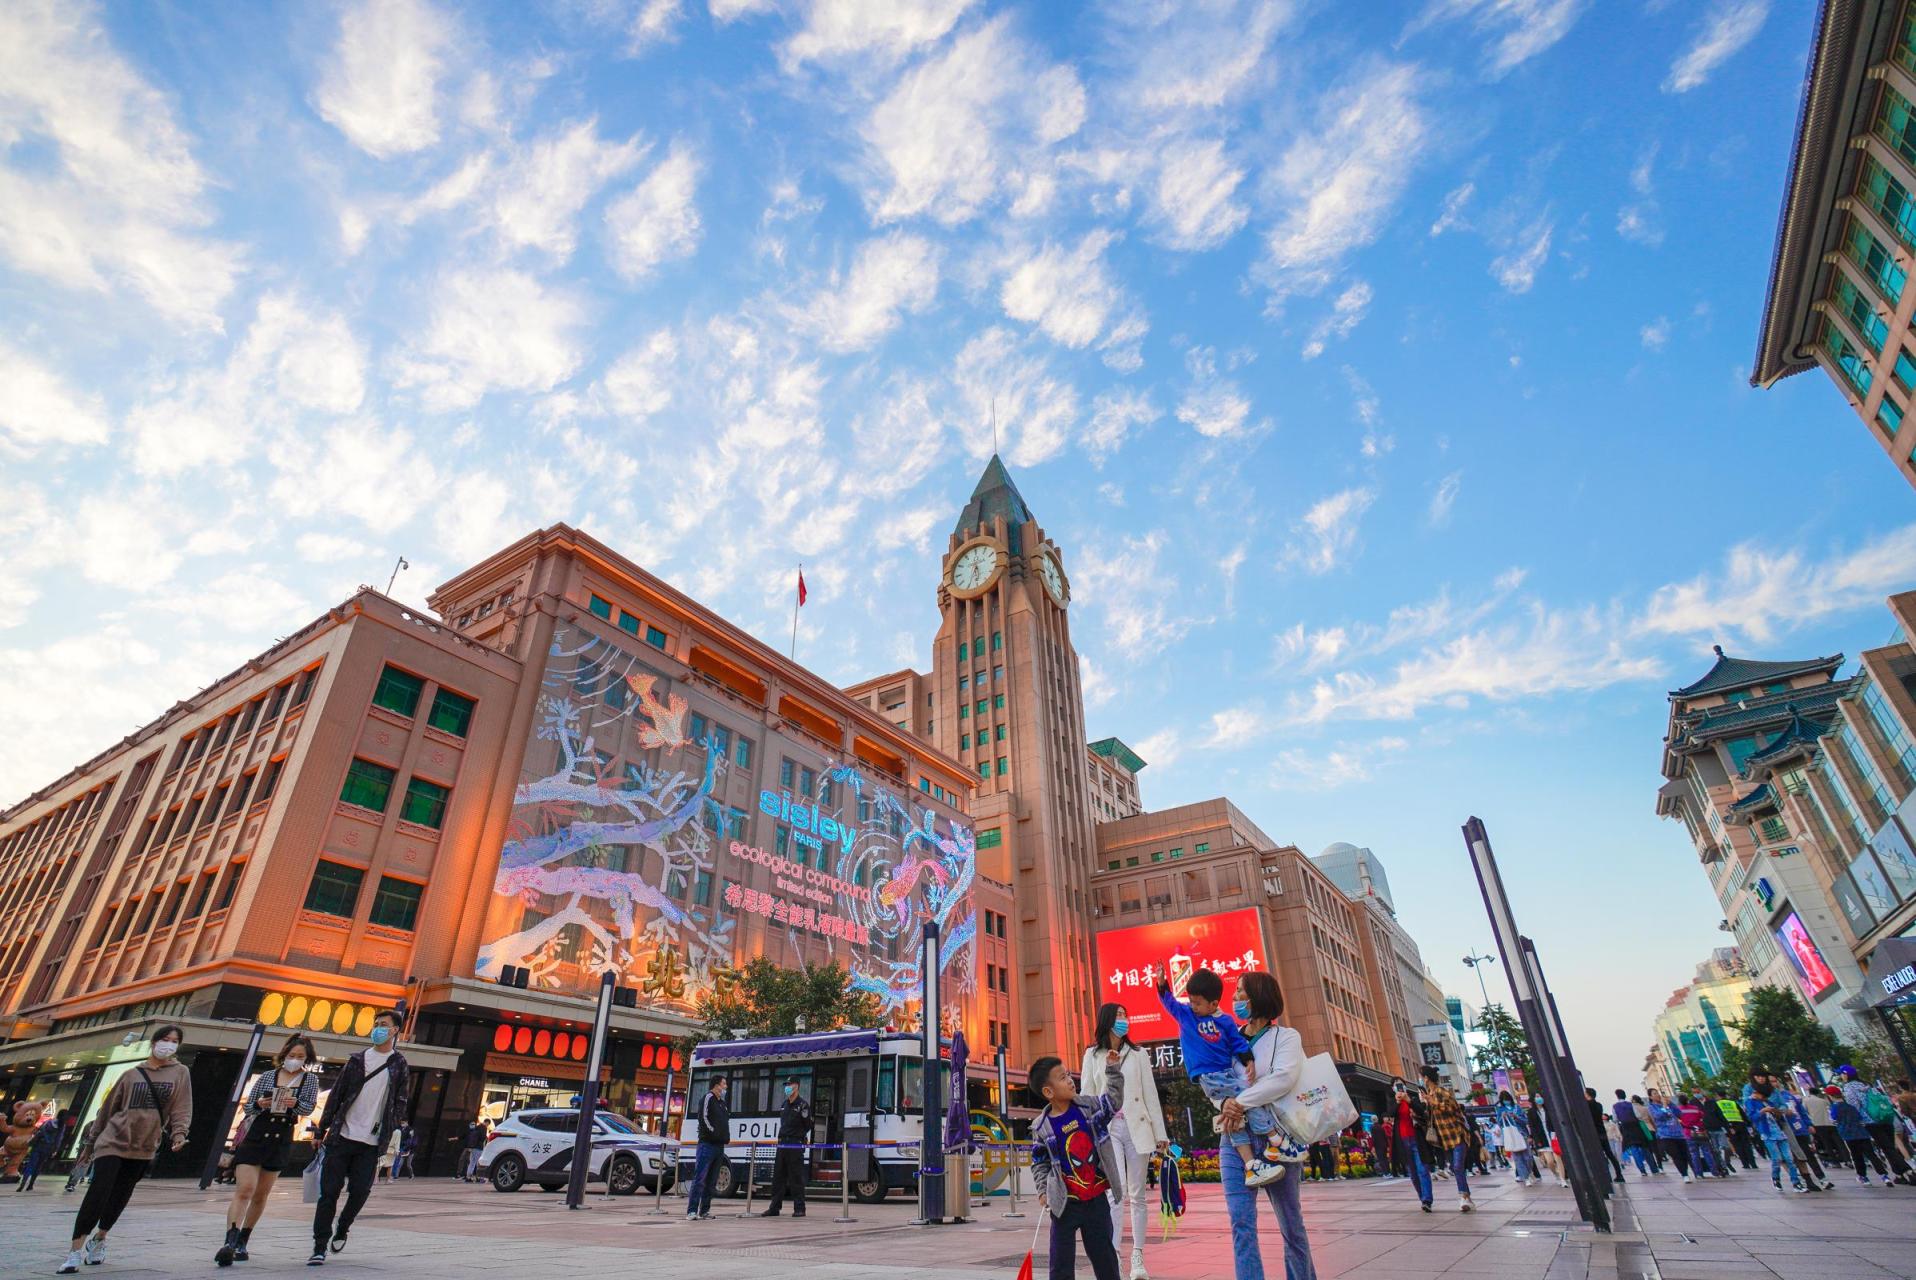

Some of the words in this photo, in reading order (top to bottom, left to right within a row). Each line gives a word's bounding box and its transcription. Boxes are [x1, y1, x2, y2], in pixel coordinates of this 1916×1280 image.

[759, 789, 857, 855] sisley
[793, 830, 823, 850] PARIS
[1769, 846, 1800, 859] apm
[729, 841, 803, 879] ecological
[806, 869, 871, 903] compound
[777, 876, 804, 897] limited
[806, 888, 833, 905] edition
[1109, 963, 1167, 994] 中国茅
[519, 1078, 550, 1088] CHANEL
[532, 1143, 552, 1154] 公安
